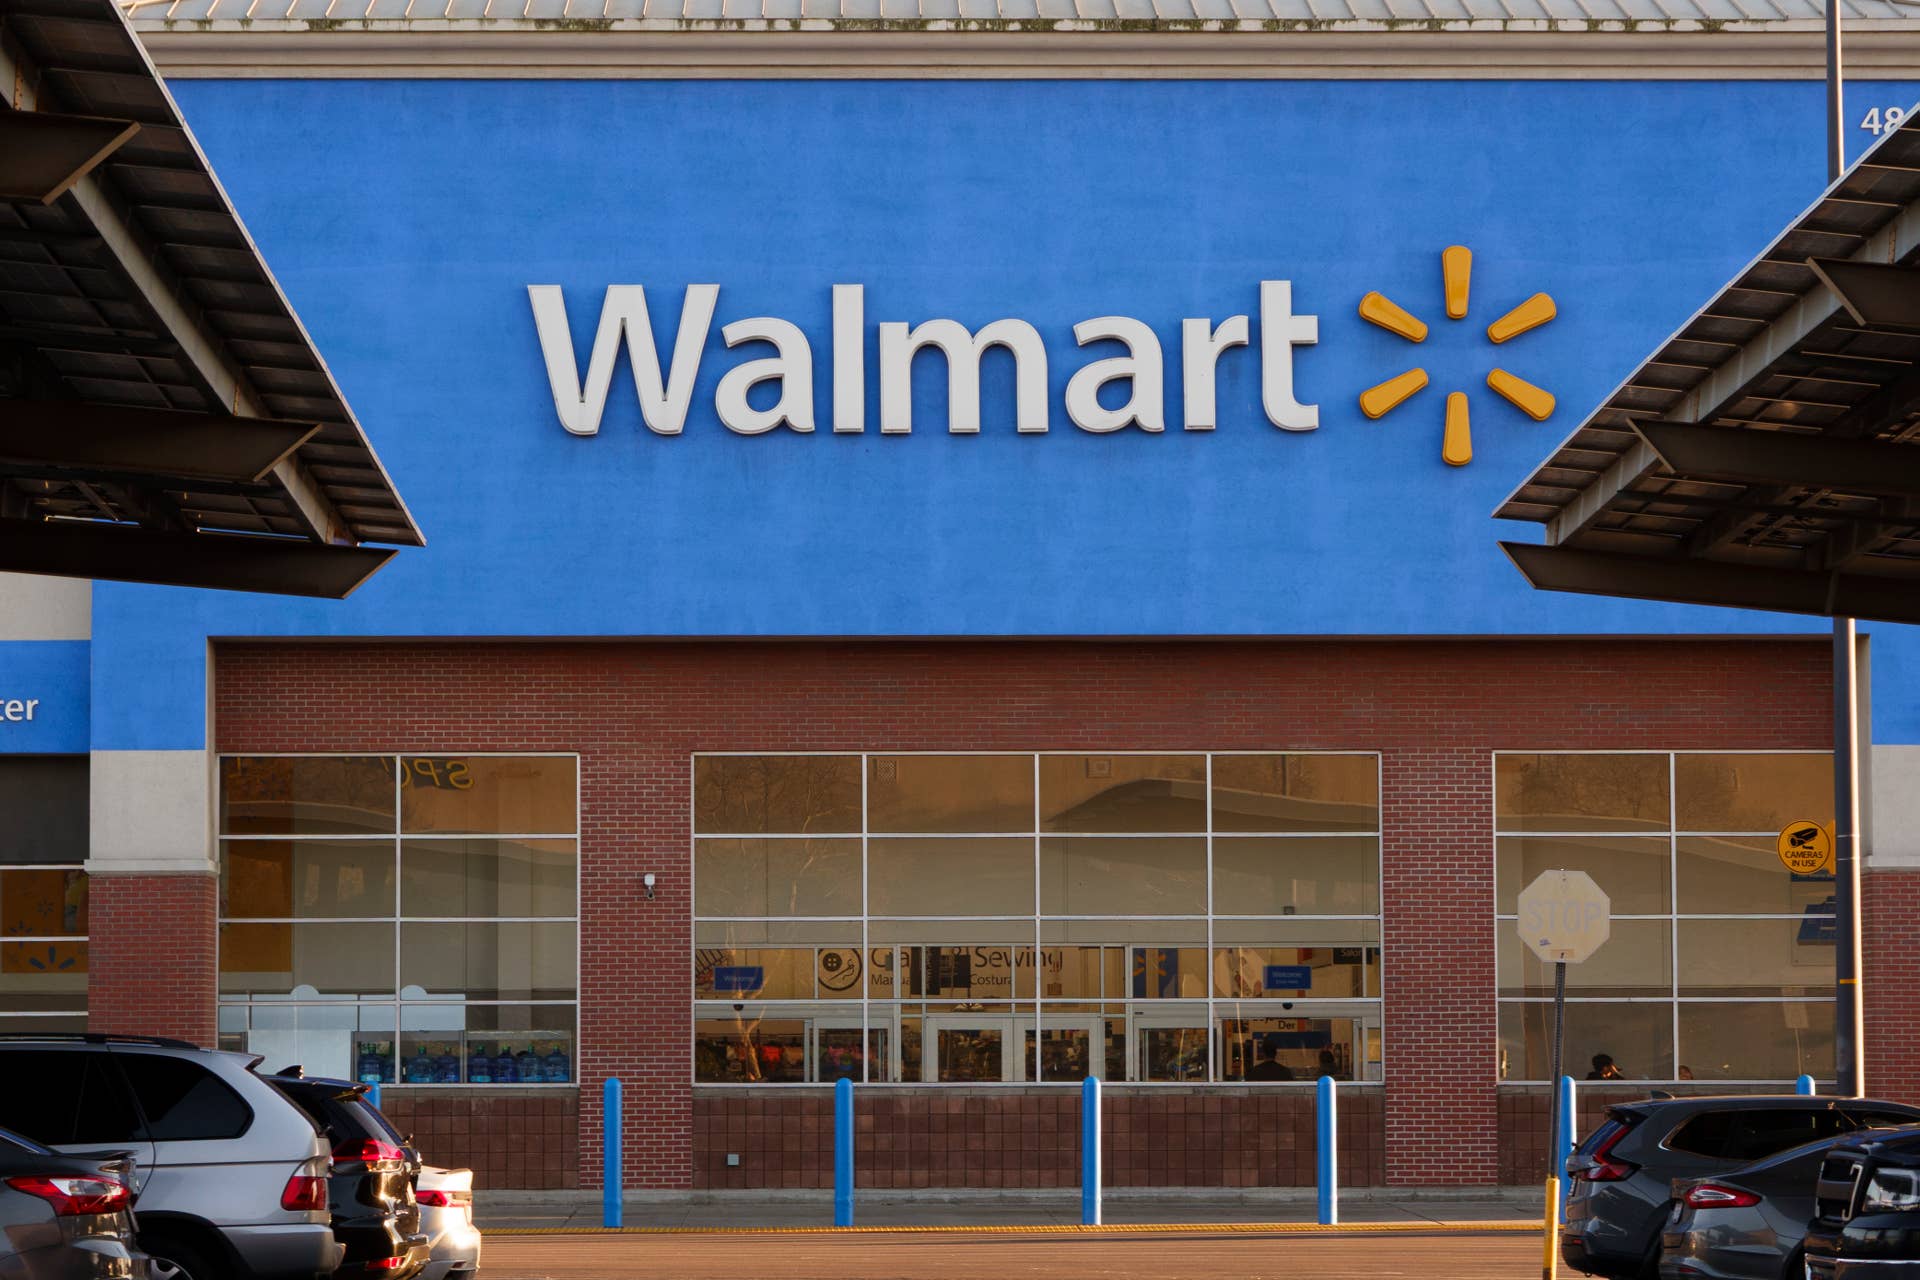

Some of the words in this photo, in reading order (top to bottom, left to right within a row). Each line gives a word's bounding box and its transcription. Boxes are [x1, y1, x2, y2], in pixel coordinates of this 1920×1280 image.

[527, 280, 1320, 435] Walmart
[1784, 850, 1823, 859] CAMERAS
[1525, 898, 1602, 934] STOP
